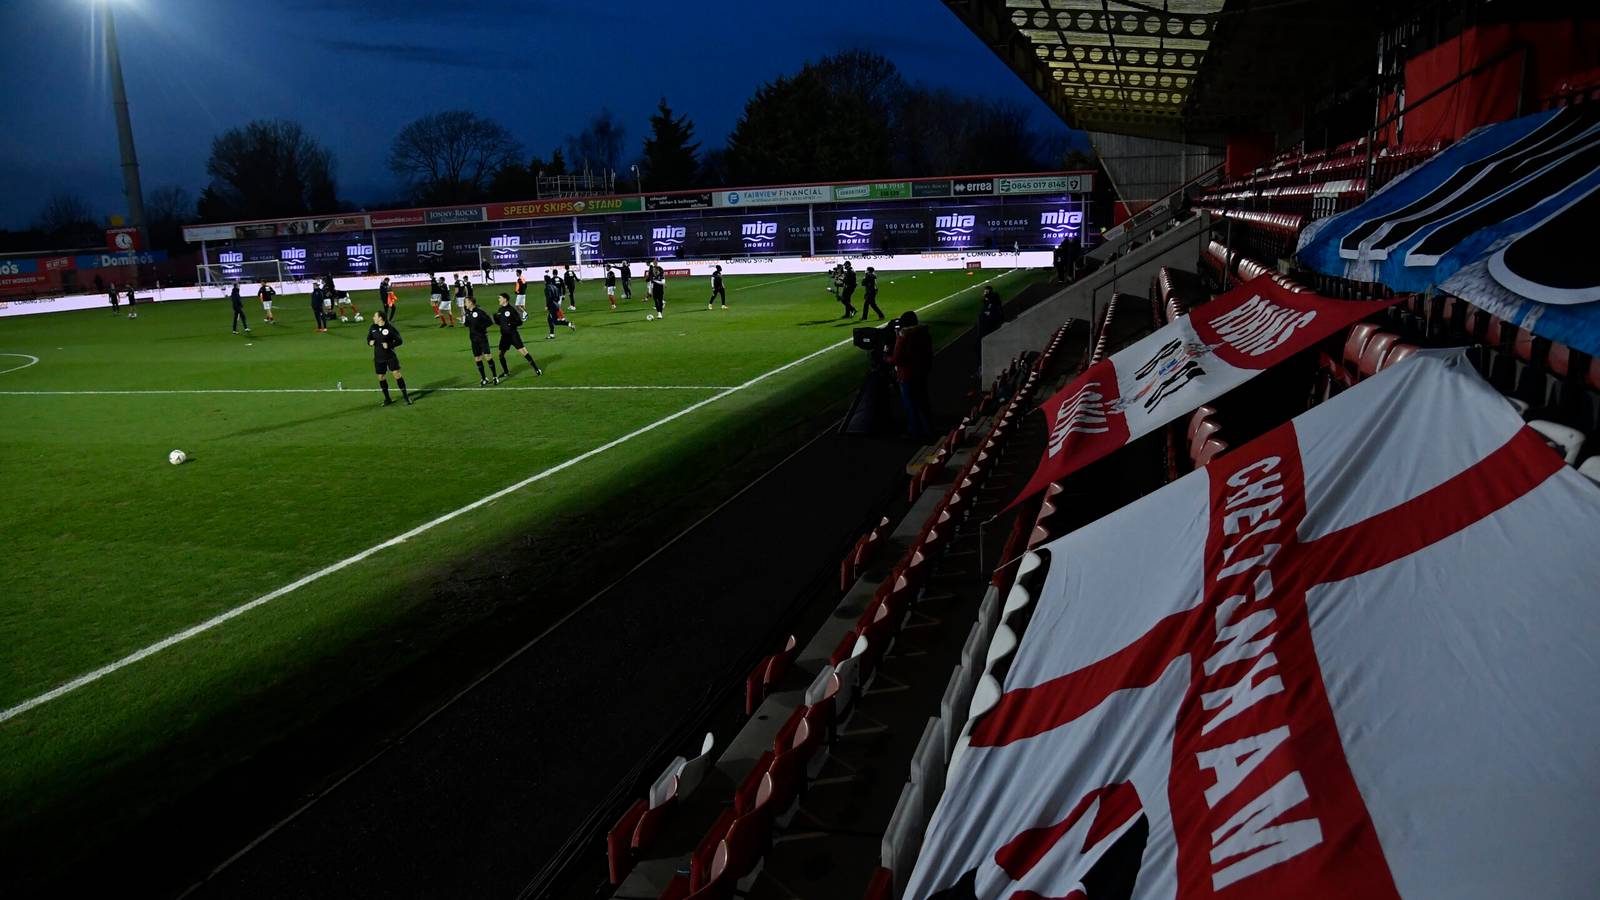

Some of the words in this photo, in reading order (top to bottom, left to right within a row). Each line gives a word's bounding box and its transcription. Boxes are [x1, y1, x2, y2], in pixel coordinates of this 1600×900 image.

[966, 181, 992, 191] errea
[1011, 182, 1031, 190] 0845
[1033, 181, 1046, 189] 017
[1048, 180, 1066, 188] 8145
[779, 188, 823, 197] FINANCIAL
[503, 205, 541, 216] SPEEDY
[543, 201, 574, 213] SKIPS
[588, 199, 623, 210] STAND
[836, 216, 874, 231] mira
[935, 213, 975, 227] mira
[1041, 209, 1083, 225] mira
[652, 225, 686, 239] mira
[742, 220, 778, 235] mira
[417, 240, 445, 252] mira
[490, 234, 521, 247] mira
[281, 247, 306, 259] mira
[346, 243, 373, 256] mira
[101, 252, 154, 268] Domino's
[219, 251, 243, 263] mira
[726, 257, 752, 265] COMING
[1207, 294, 1318, 357] ROBINS
